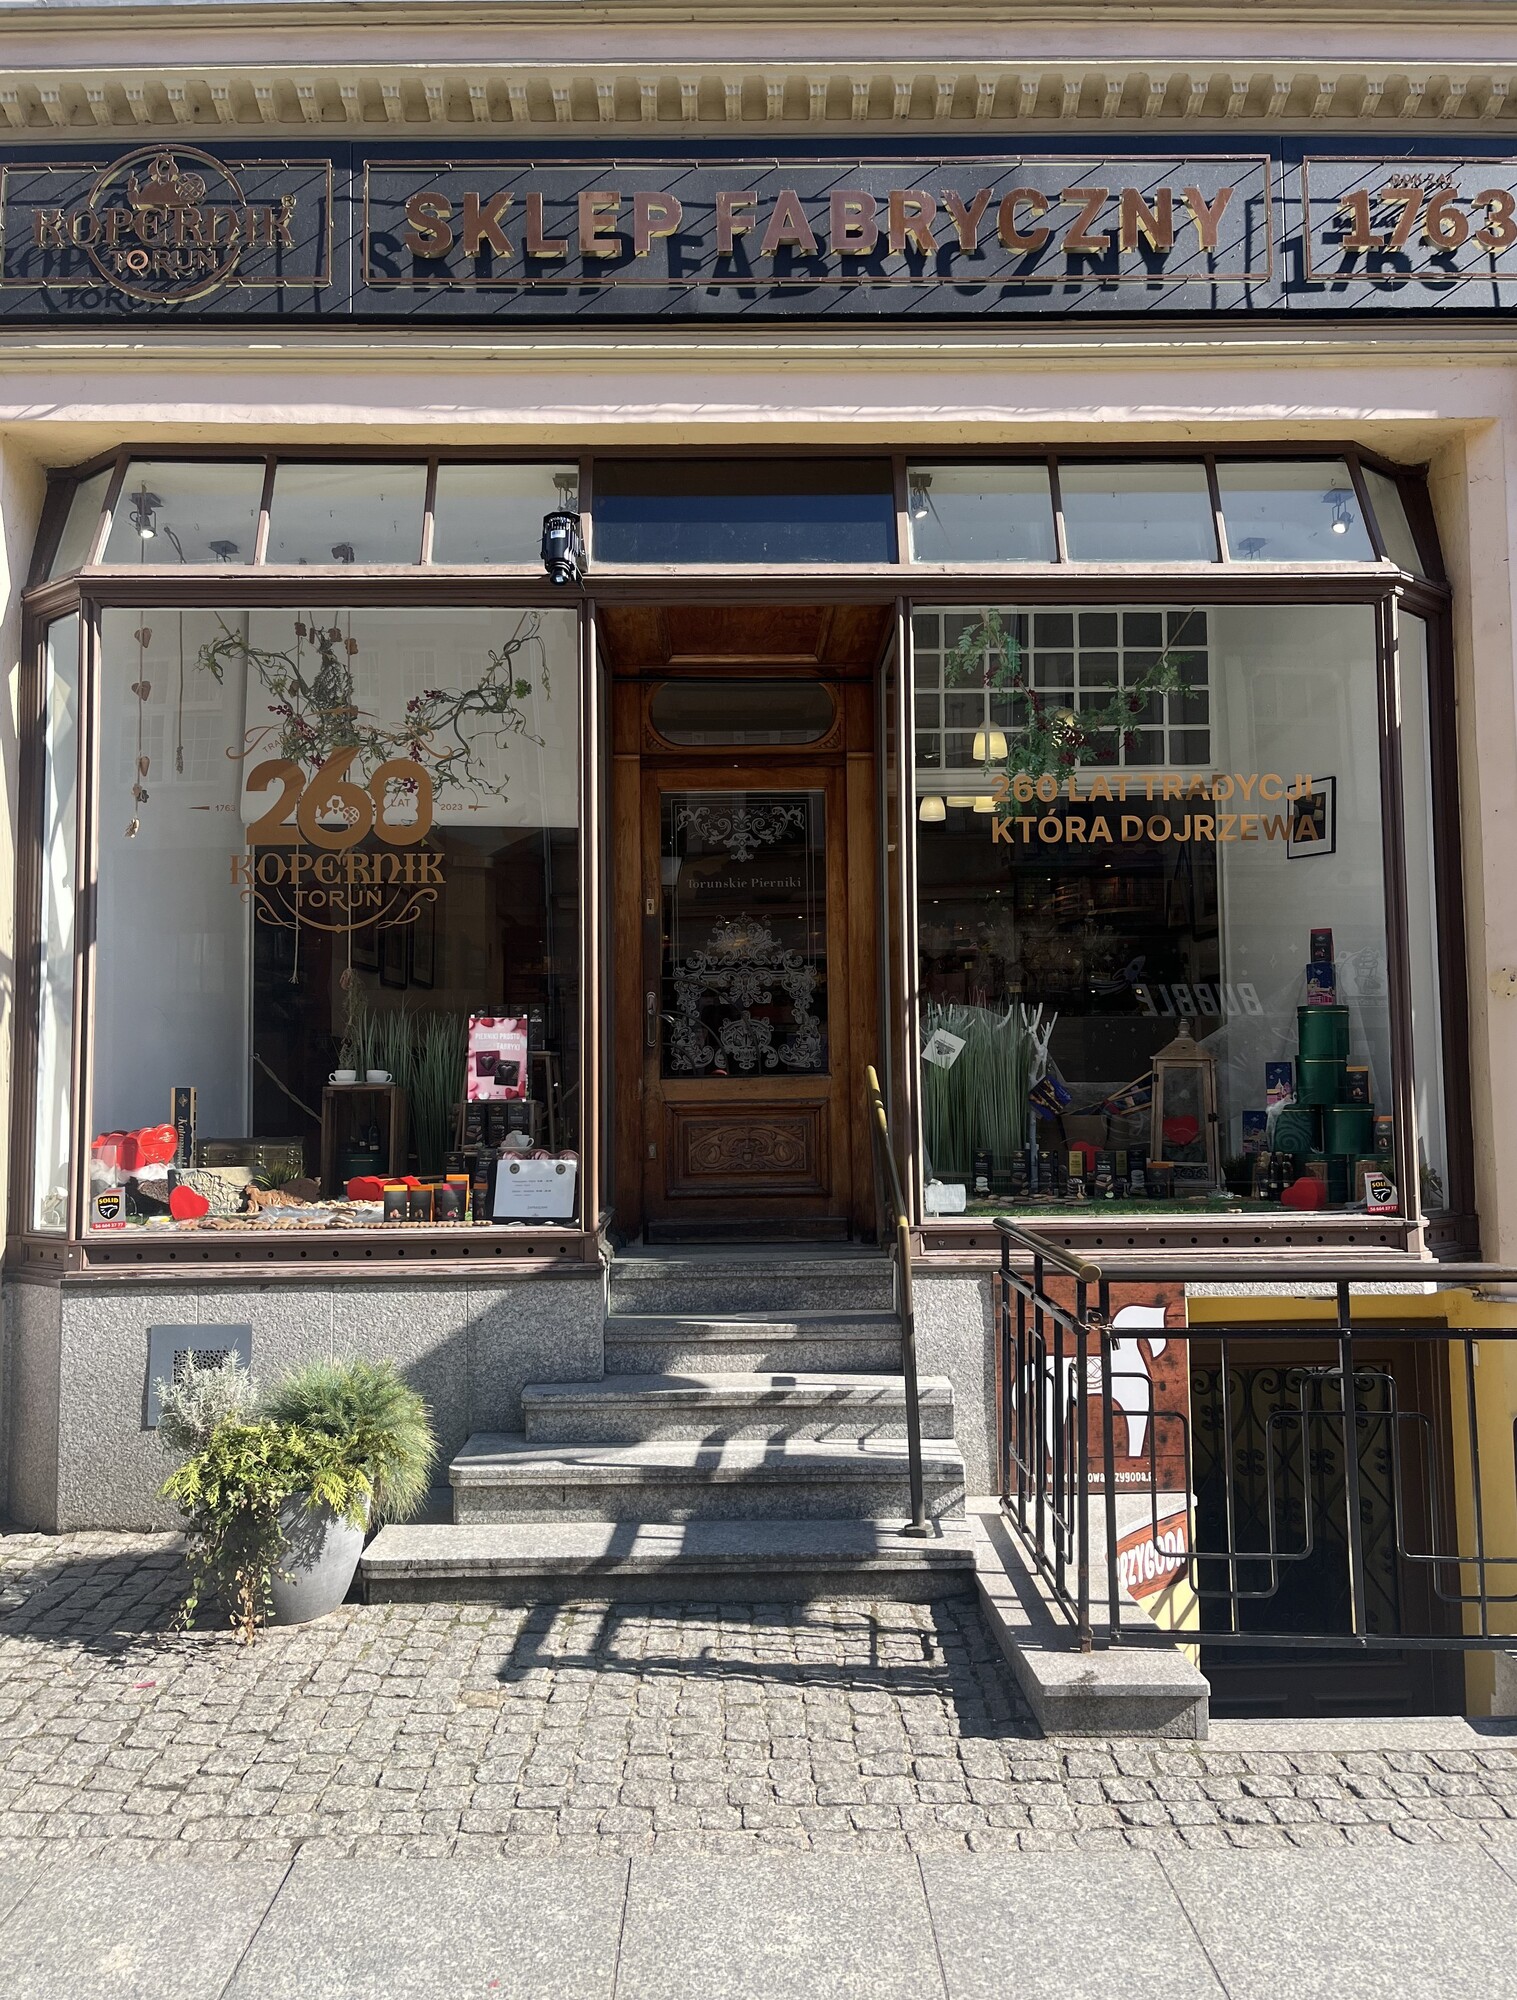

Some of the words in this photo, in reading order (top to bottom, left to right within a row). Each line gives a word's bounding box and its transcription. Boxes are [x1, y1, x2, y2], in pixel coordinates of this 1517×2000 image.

[31, 207, 296, 248] KOPERNIK
[403, 191, 684, 256] SKLEP
[714, 187, 1235, 254] FABRYCZNY
[1340, 187, 1517, 249] 1763
[215, 804, 236, 812] 1763
[391, 797, 411, 807] LAT
[440, 803, 463, 811] 2023
[245, 745, 434, 850] 260
[990, 774, 1059, 802] 260
[1068, 774, 1135, 802] LAT
[1139, 773, 1313, 801] TRADYCJI
[991, 808, 1114, 844] KTÓRA
[1121, 813, 1320, 842] DOJRZEWA
[229, 852, 447, 885] KOPERNIK
[751, 876, 801, 888] Pierniki
[1116, 1527, 1186, 1590] RZYGODA
